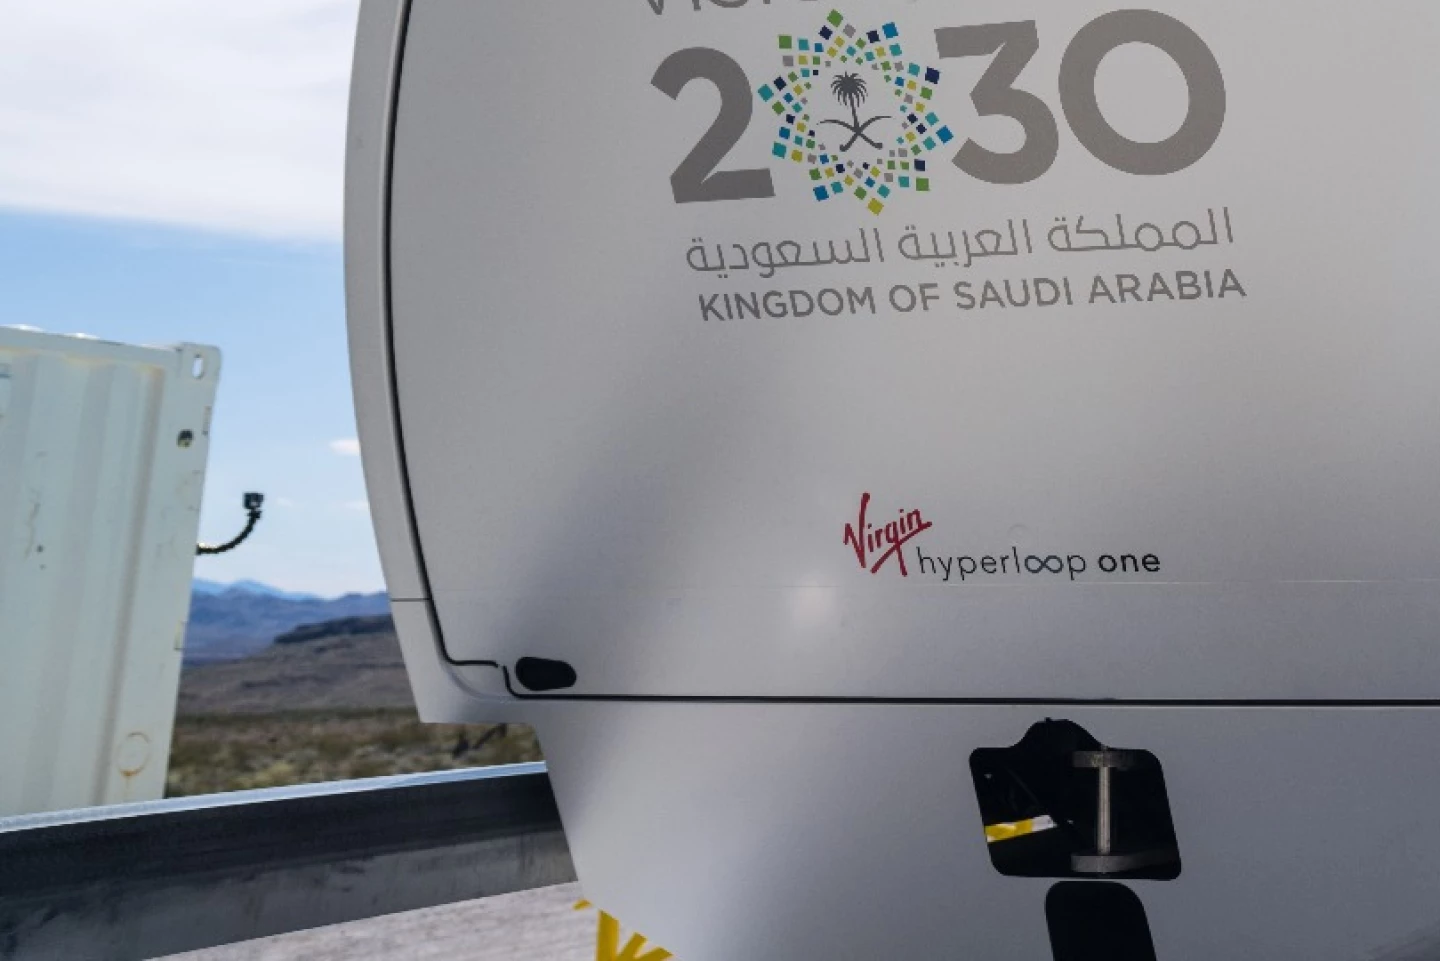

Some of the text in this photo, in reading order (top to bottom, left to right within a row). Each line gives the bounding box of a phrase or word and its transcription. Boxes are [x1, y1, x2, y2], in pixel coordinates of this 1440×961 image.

[685, 206, 1235, 279] المملكة العربية السعودية
[697, 268, 1248, 322] KINGDOM OF SAUDI ARABIA
[843, 492, 933, 577] Virgin
[915, 546, 1161, 582] hyperloop one
